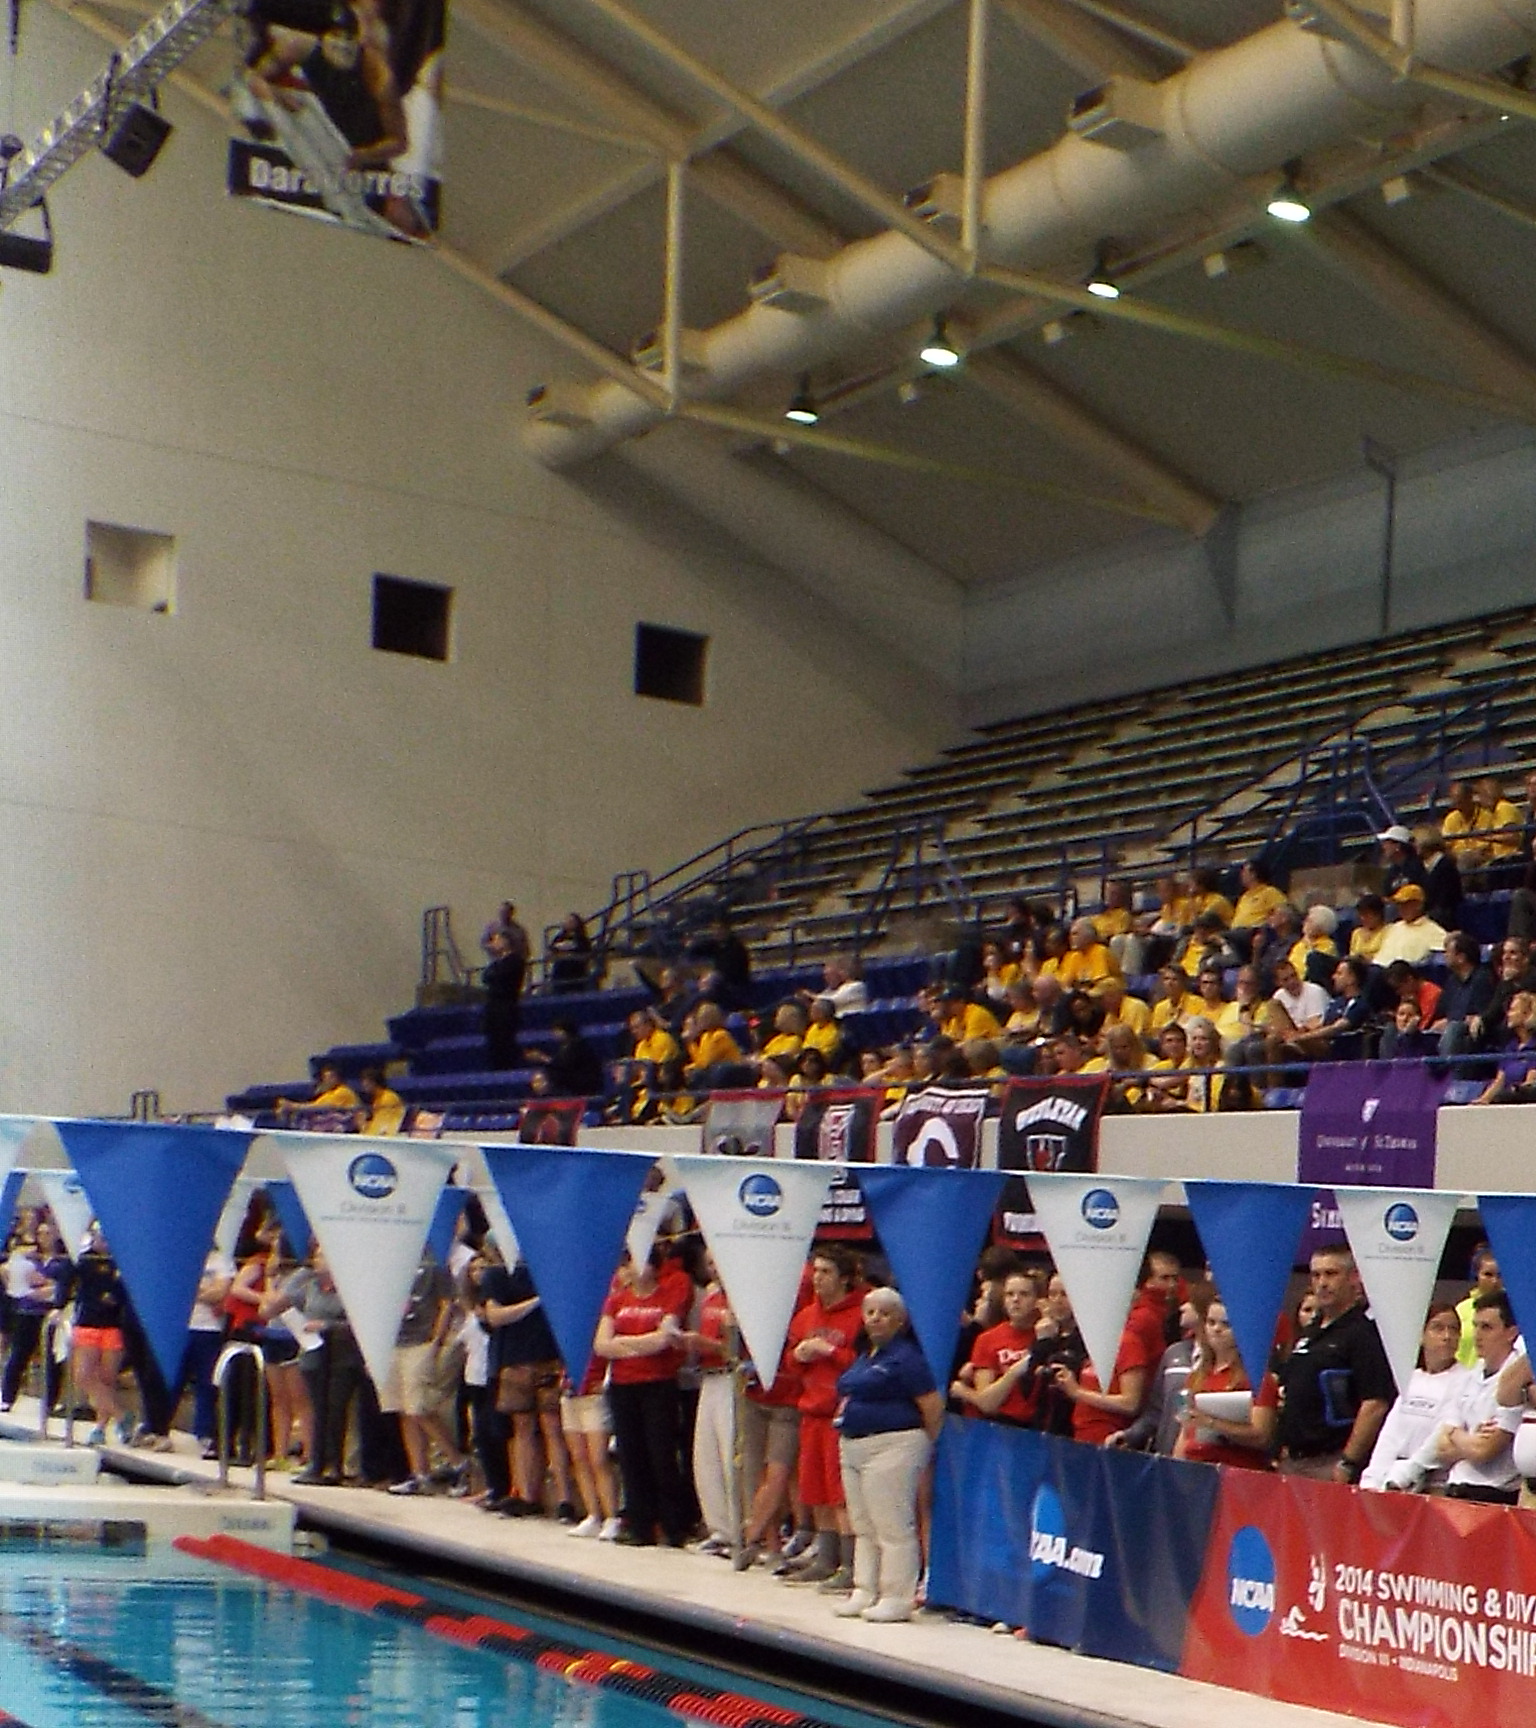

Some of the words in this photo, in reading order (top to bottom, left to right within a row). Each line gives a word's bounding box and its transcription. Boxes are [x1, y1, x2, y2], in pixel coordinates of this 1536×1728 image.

[1230, 1578, 1276, 1613] NCAA
[1335, 1563, 1374, 1597] 2014
[1377, 1571, 1479, 1616] SWIMMING
[1483, 1587, 1503, 1619] &
